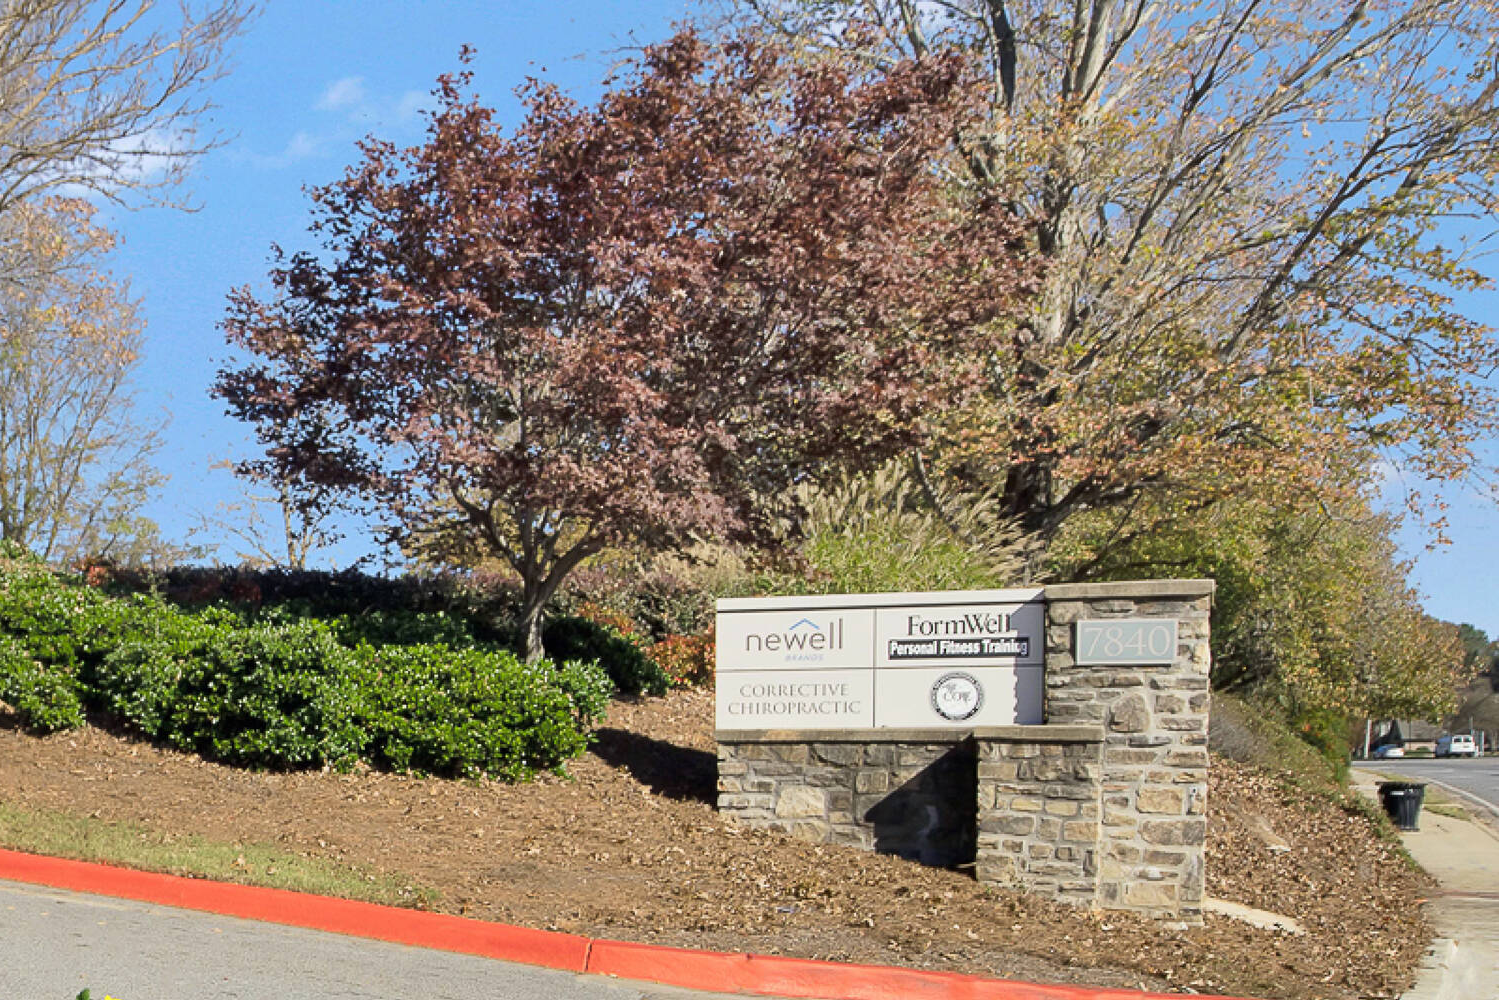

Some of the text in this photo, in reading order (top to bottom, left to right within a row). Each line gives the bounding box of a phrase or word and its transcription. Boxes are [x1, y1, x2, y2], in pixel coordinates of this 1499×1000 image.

[745, 617, 844, 652] newell
[907, 613, 1012, 636] FormWell
[890, 637, 1029, 656] Personal Fitness Training
[1083, 625, 1171, 657] 7840
[739, 682, 850, 699] CORRECTIVE
[727, 700, 861, 715] CHIROPRACTIC
